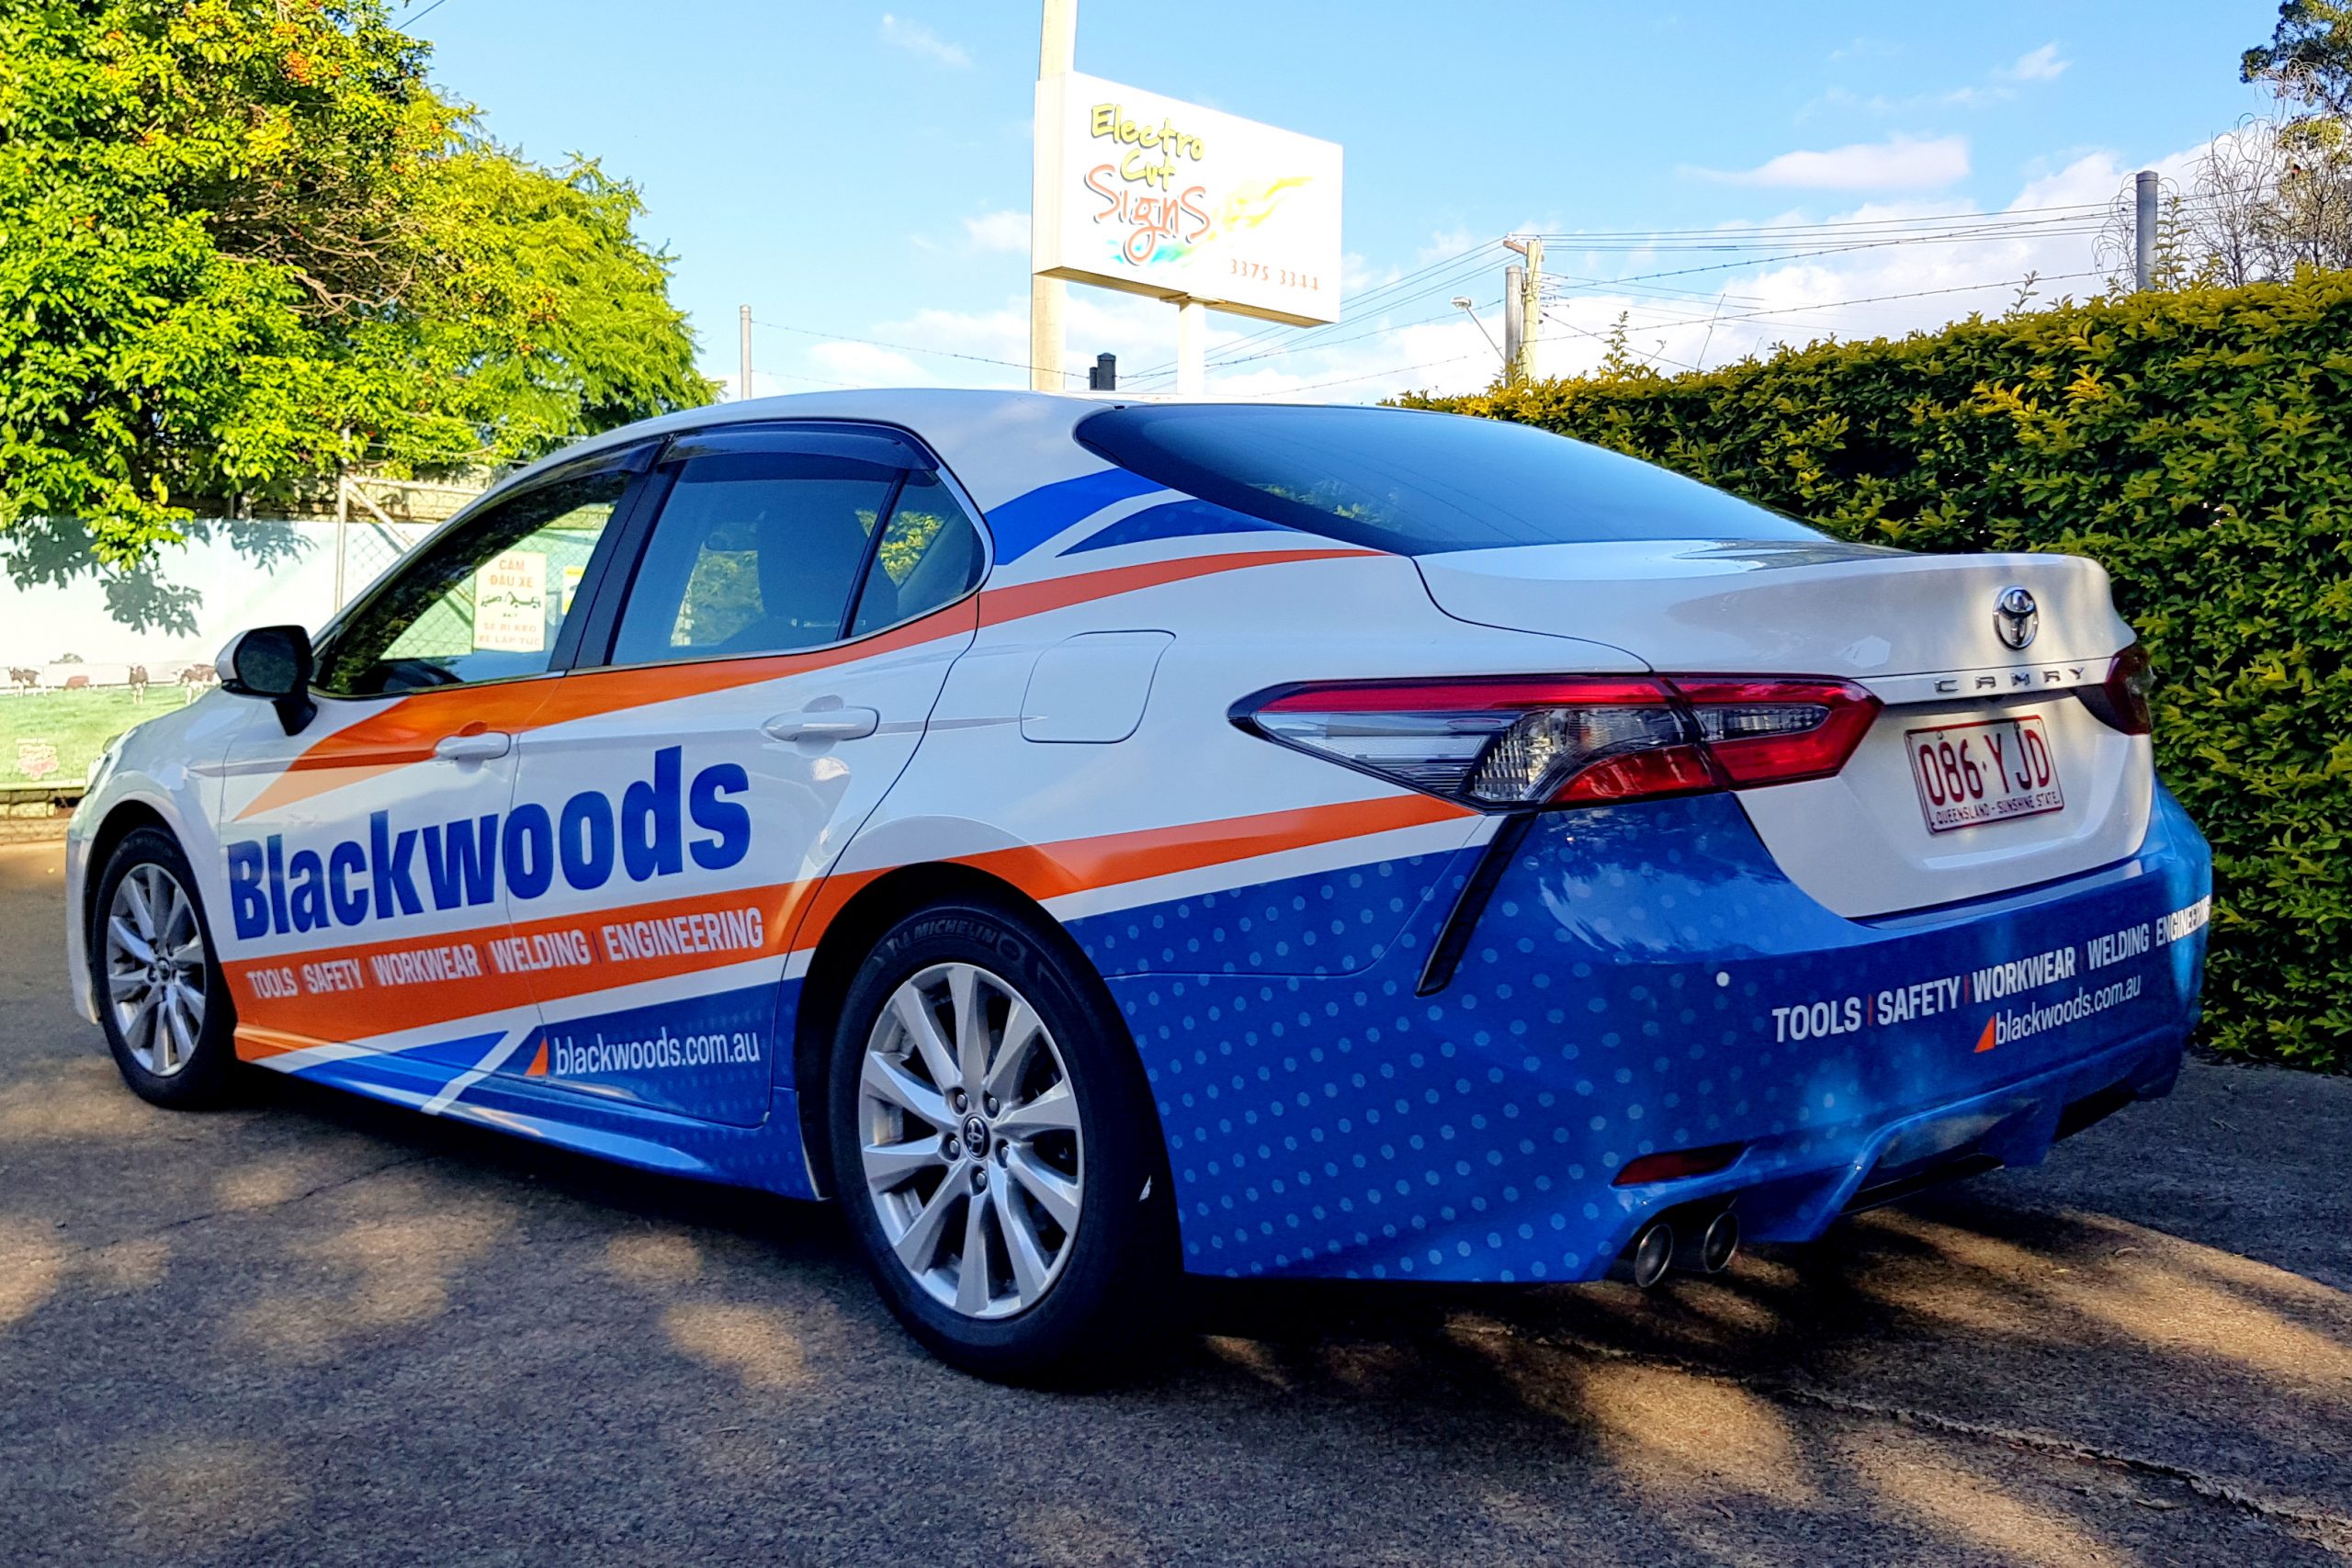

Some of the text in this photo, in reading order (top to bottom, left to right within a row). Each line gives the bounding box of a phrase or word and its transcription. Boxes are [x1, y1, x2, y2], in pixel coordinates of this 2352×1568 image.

[1091, 103, 1204, 160] Electro
[1120, 148, 1176, 191] Cut
[1230, 258, 1319, 291] 3375 3344
[1934, 667, 2085, 693] CAMRY
[1936, 803, 1990, 824] QUEENSLAND
[1996, 795, 2035, 815] SUNSHINE
[2036, 791, 2060, 807] STATE
[227, 745, 752, 941] Blackwoods
[246, 907, 764, 1000] TOOLS SAFETY WORKWEAR WELDING ENGINEERING
[1772, 997, 1862, 1043] TOOLS
[1877, 976, 1962, 1026] SAFETY
[1973, 945, 2076, 1003] WORKWEAR
[2087, 923, 2150, 971] WELDING
[1996, 974, 2142, 1045] blackwoods.com.au
[555, 1026, 761, 1076] blackwoods.com.au
